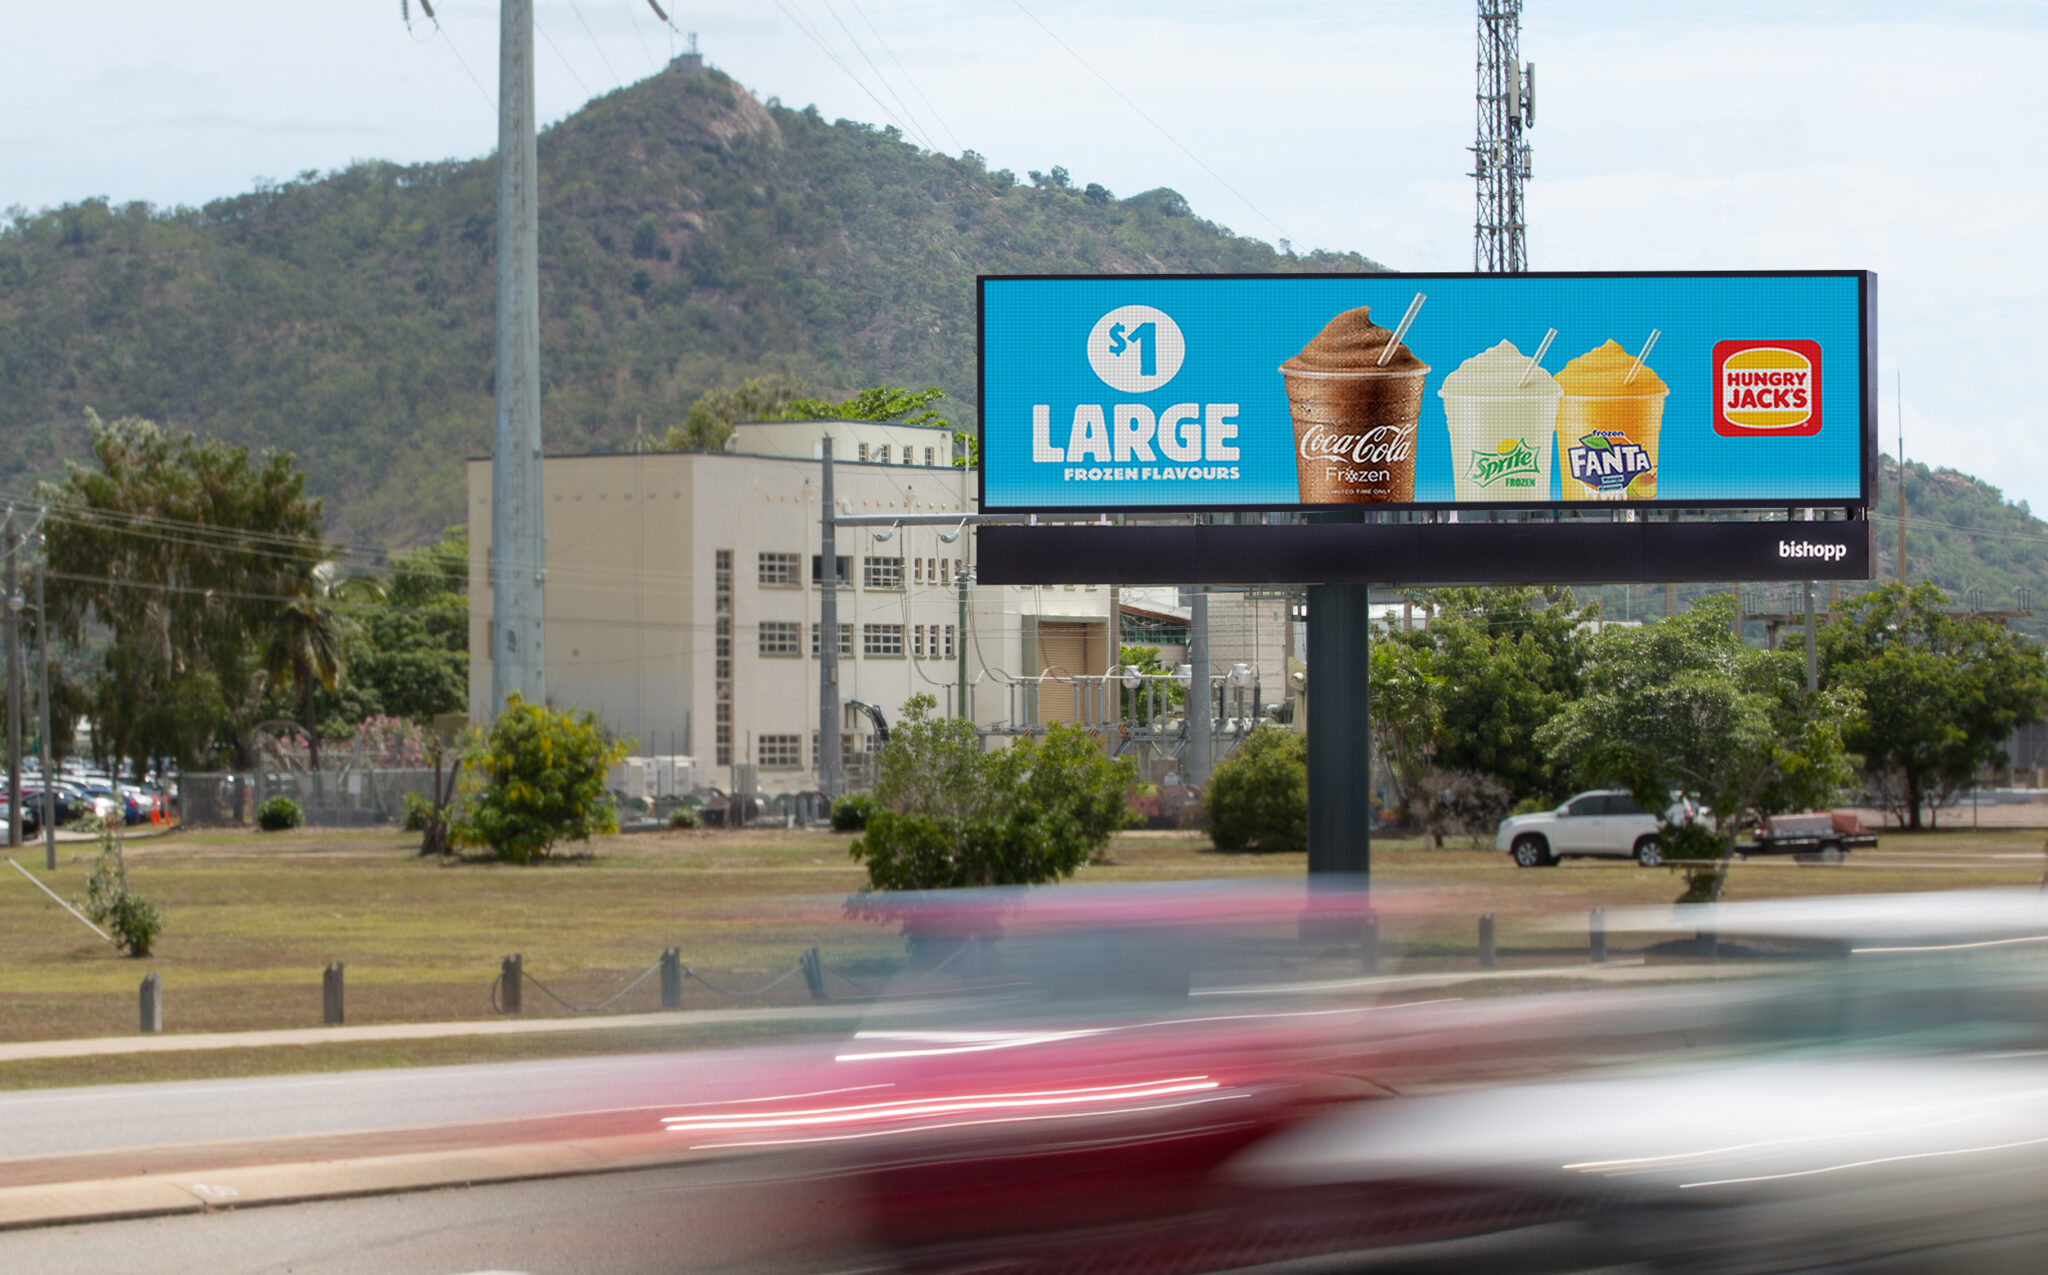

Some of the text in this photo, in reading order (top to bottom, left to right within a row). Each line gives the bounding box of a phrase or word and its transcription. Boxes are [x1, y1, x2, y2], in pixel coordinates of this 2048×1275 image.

[1108, 321, 1157, 377] $1
[1727, 372, 1808, 387] HUNGRY
[1727, 388, 1808, 409] JACK'S
[1032, 403, 1241, 463] LARGE
[1592, 430, 1625, 438] frozen
[1472, 448, 1533, 482] Sprite
[1569, 446, 1651, 478] FANTA
[1064, 467, 1240, 481] FROZEN FLAVOURS
[1325, 466, 1390, 483] Frozen
[1505, 478, 1536, 487] FROZEN
[1779, 541, 1847, 561] bishopp
